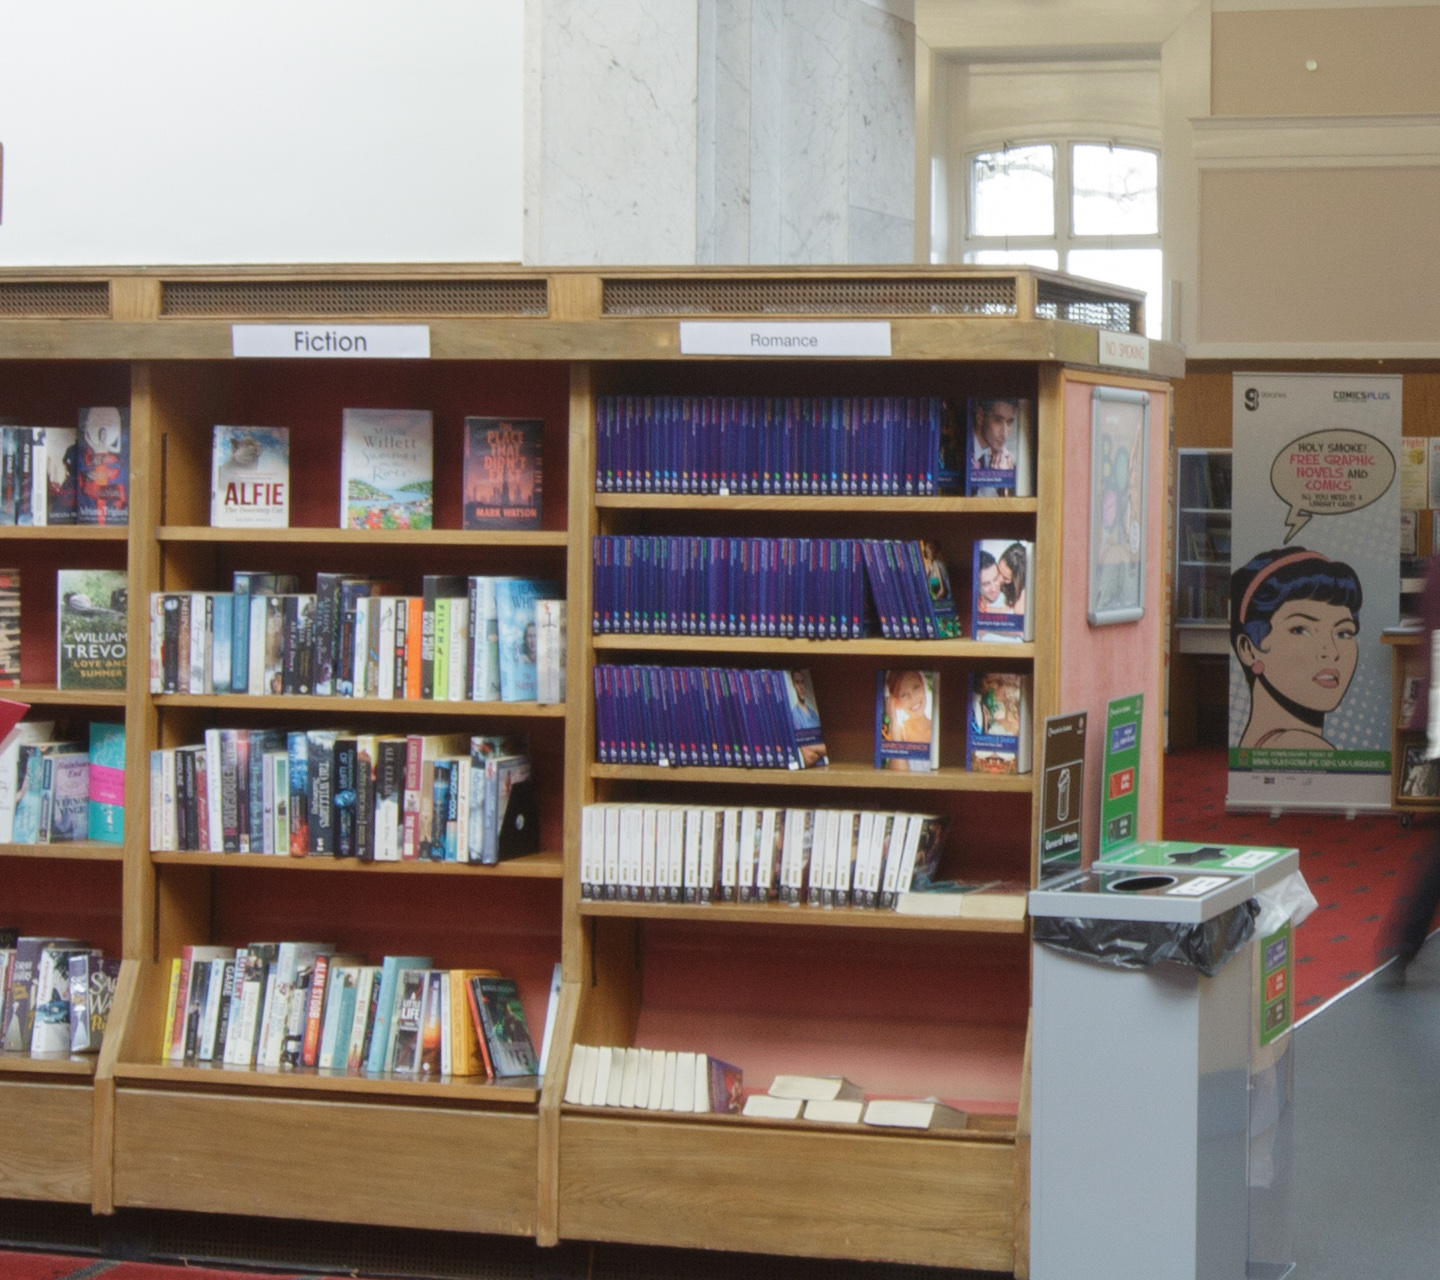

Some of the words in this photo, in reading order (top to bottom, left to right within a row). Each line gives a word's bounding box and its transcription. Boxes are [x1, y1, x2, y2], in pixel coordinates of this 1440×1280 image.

[293, 330, 368, 352] Fiction
[750, 331, 819, 349] Romance
[363, 435, 416, 449] Willett
[1298, 443, 1323, 452] HOLY
[1328, 443, 1367, 452] SMOKE!
[1289, 454, 1320, 465] FREE
[1324, 454, 1376, 466] GRAPHIC
[1296, 467, 1344, 478] NOVELS
[1347, 470, 1368, 478] AND
[1305, 480, 1352, 491] COMICS
[224, 482, 284, 506] ALFIE
[476, 507, 500, 518] MARK
[501, 509, 537, 518] WATSON
